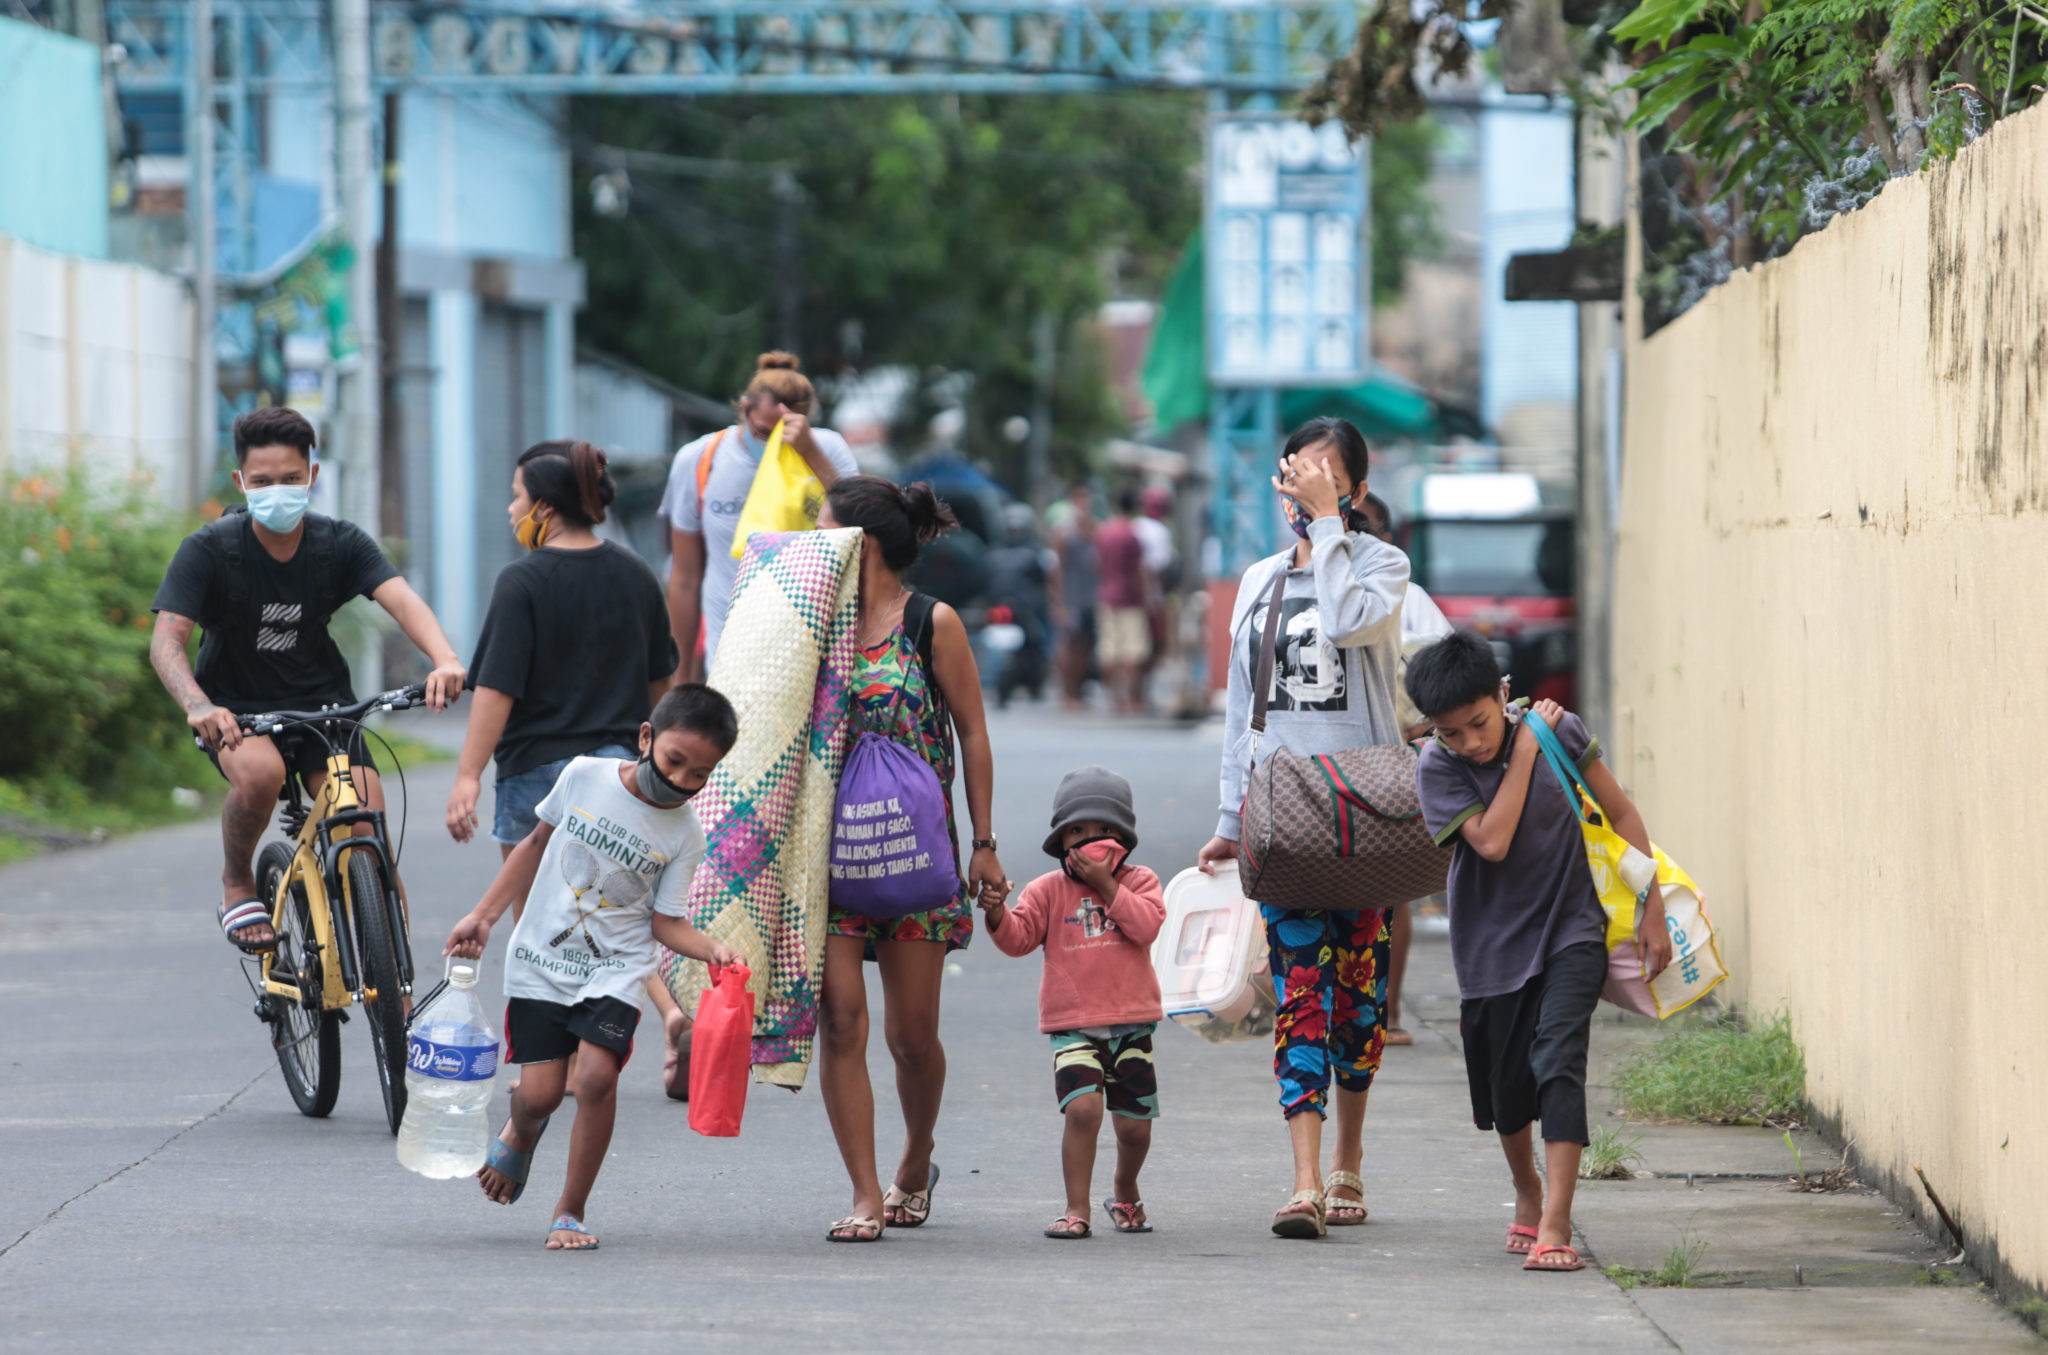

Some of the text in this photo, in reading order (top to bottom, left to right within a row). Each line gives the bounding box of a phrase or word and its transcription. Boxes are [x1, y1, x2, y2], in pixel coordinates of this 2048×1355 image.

[597, 816, 652, 855] CLUB DES
[875, 821, 886, 838] AY
[566, 815, 666, 875] BADMINTON
[852, 843, 882, 860] AKONG
[883, 835, 917, 856] KWENTA
[868, 862, 886, 879] ANG
[886, 856, 913, 876] TAMIS
[515, 947, 626, 978] CHAMPIONIPS
[562, 948, 591, 966] 1999
